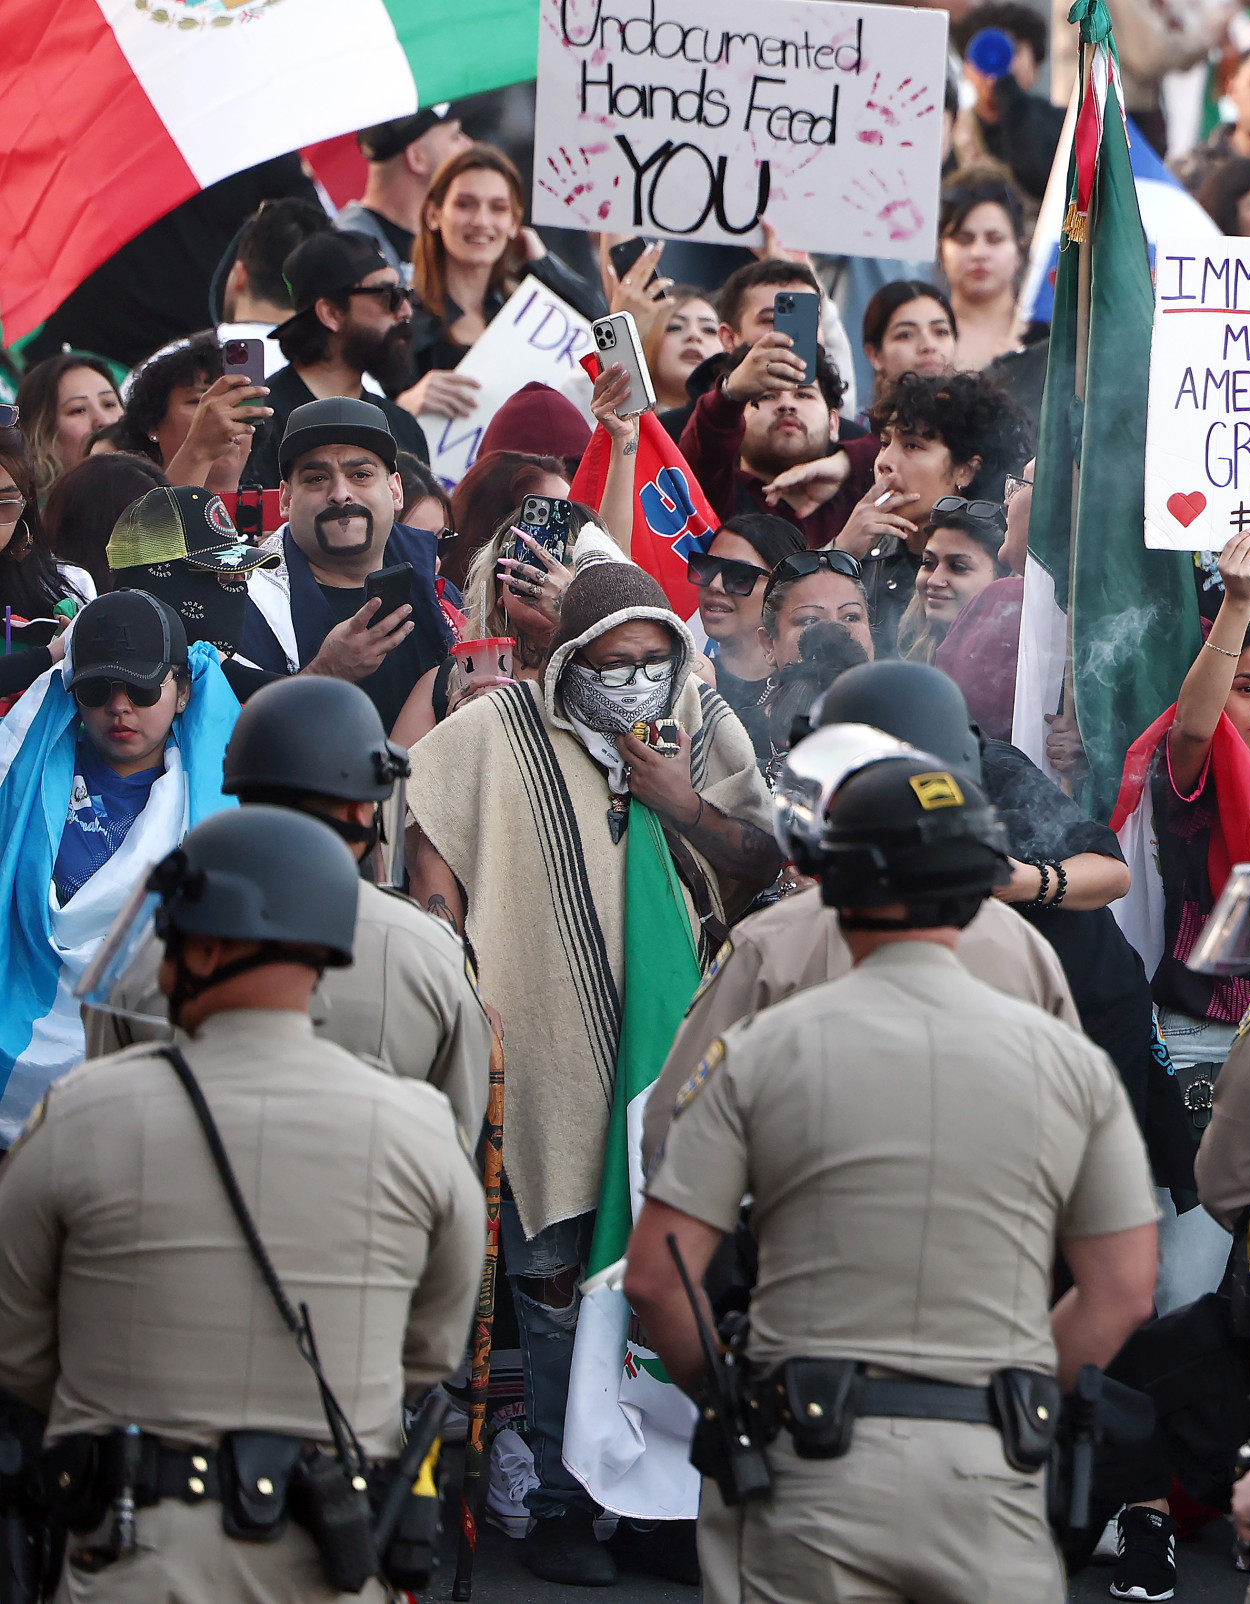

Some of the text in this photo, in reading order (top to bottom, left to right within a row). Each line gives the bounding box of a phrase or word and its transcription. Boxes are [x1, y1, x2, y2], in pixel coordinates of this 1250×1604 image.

[560, 0, 864, 76] Undocumented
[580, 60, 840, 145] Hands Feed
[615, 134, 771, 234] YOU
[527, 302, 592, 369] DR
